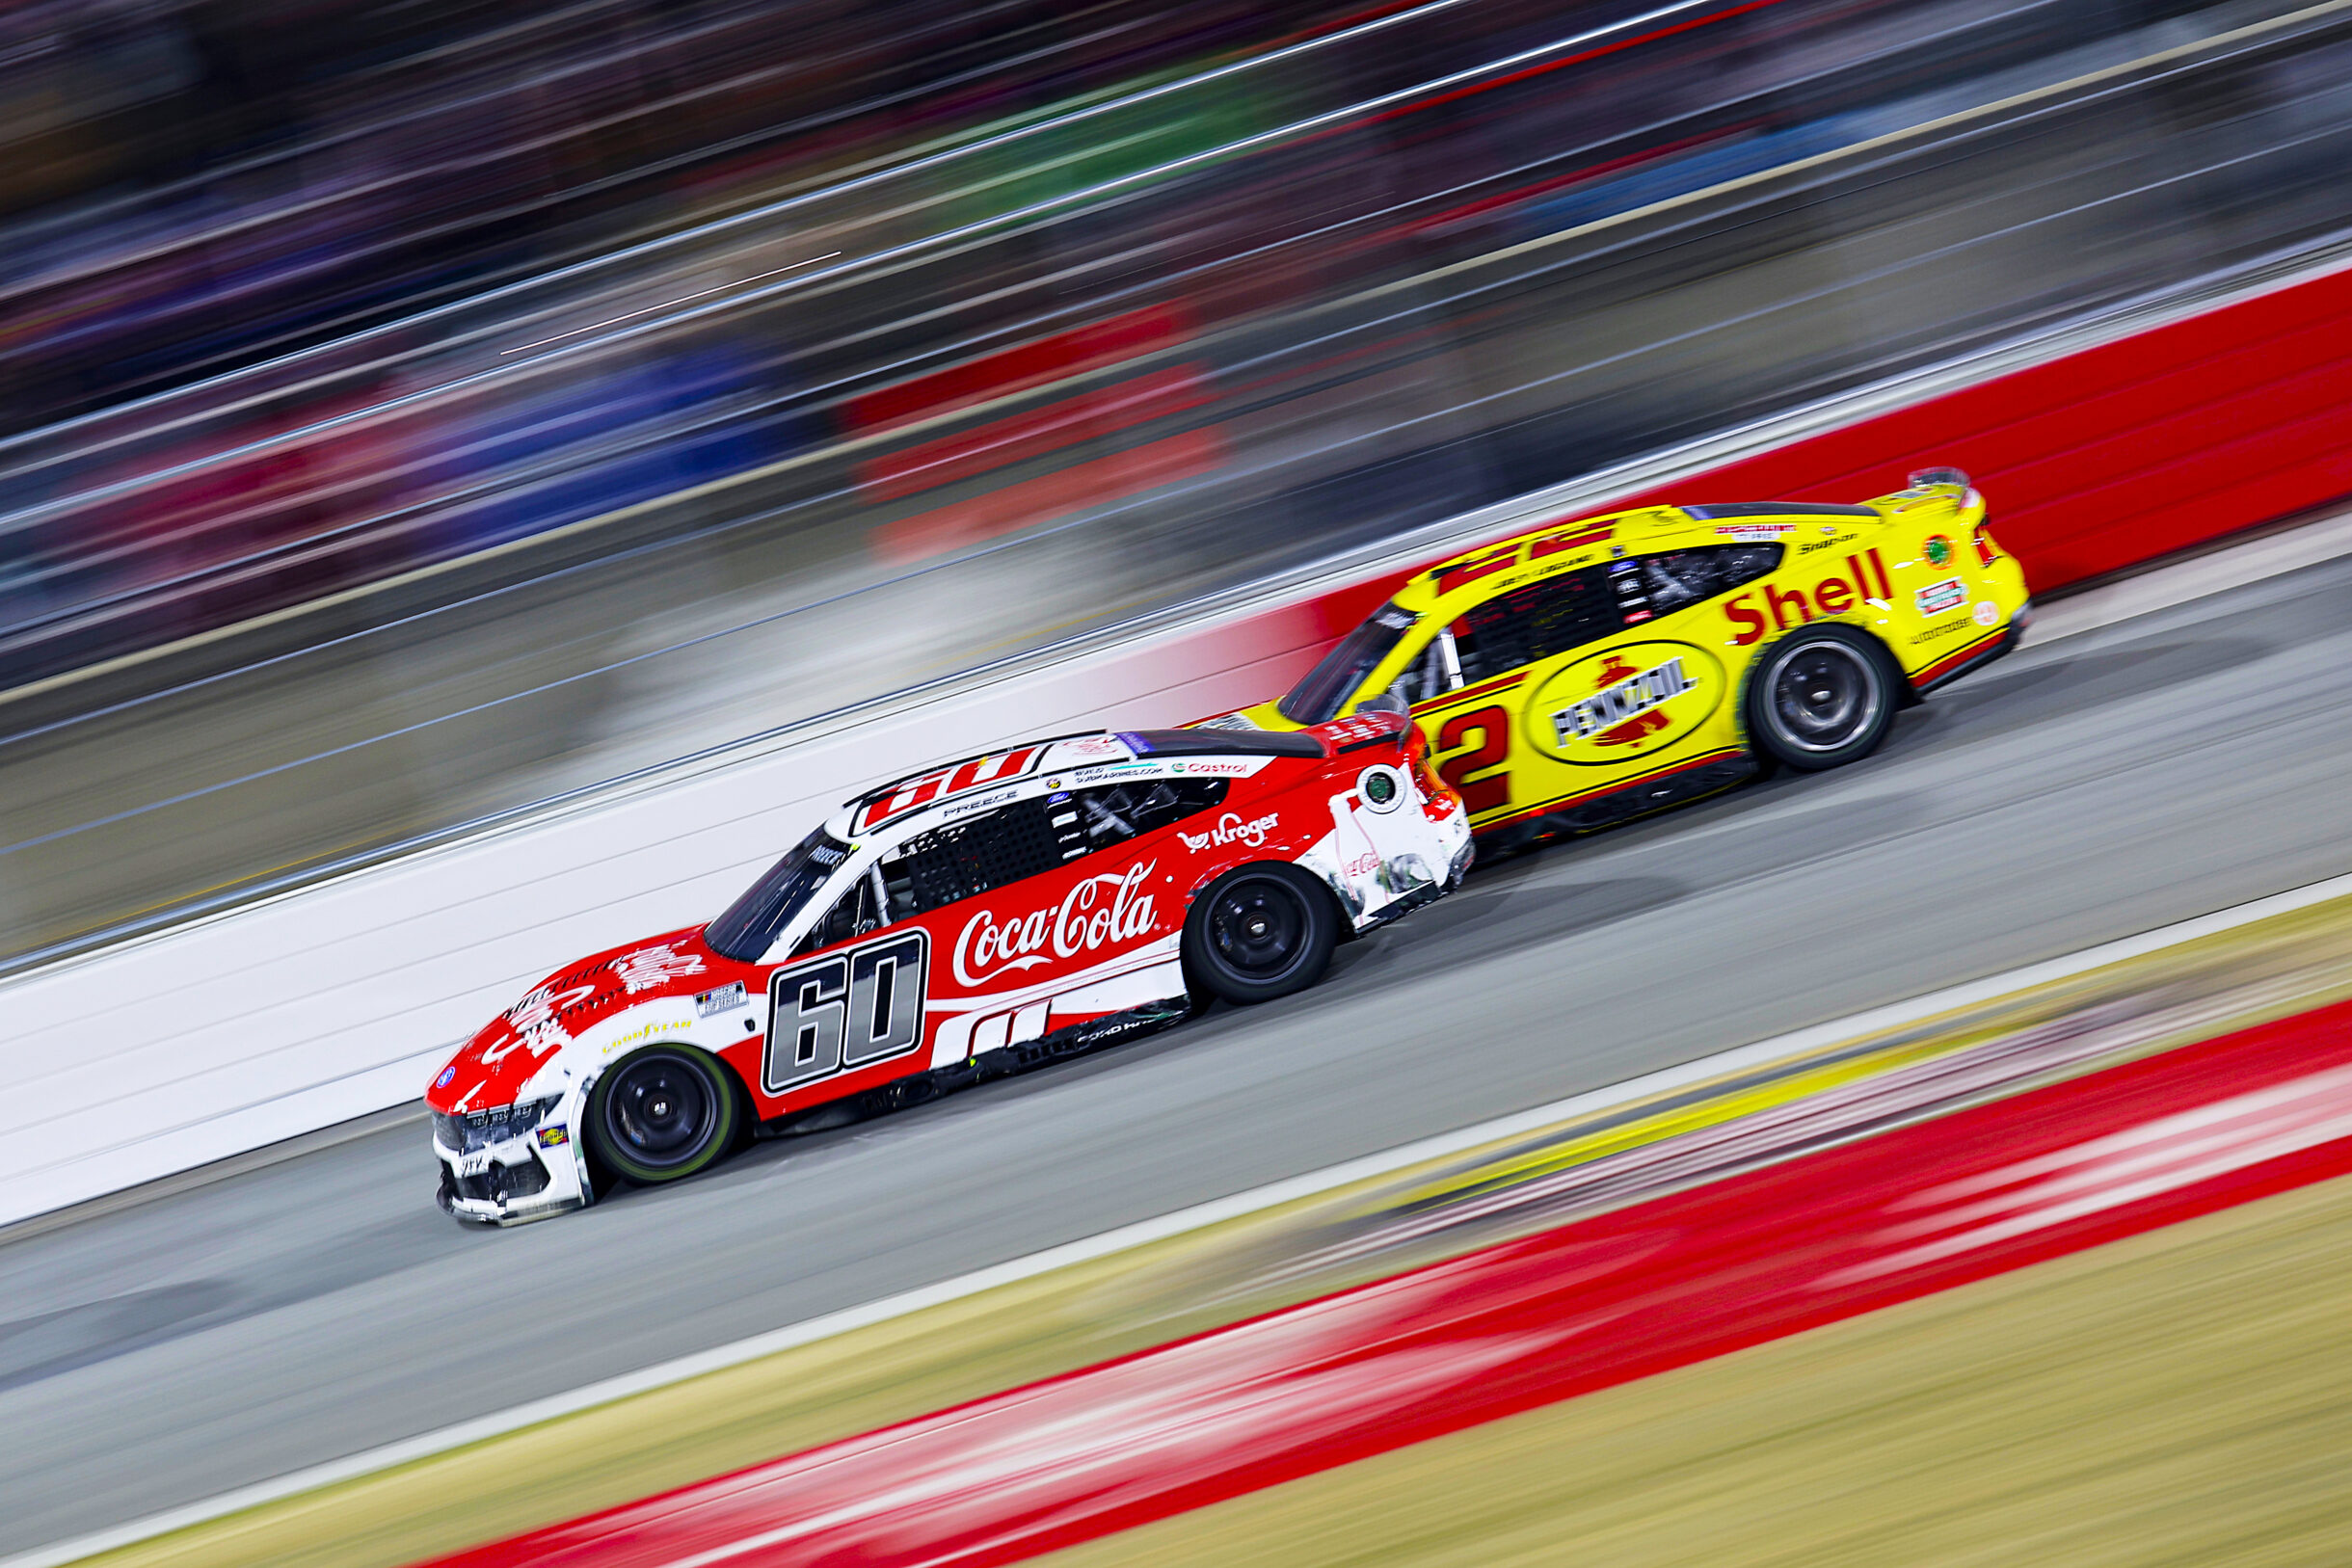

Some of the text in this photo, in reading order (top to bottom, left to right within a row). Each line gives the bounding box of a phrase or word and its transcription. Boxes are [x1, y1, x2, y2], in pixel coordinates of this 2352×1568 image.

[1724, 547, 1893, 646] Shell
[1548, 656, 1698, 749] PENNZOIL
[859, 742, 1041, 832] 60
[943, 789, 1019, 818] PREECE
[1188, 762, 1248, 774] Castrol
[1211, 812, 1280, 847] Kroger
[952, 858, 1158, 988] Coca-Cola
[602, 1020, 692, 1053] GOODYEAR
[761, 927, 931, 1097] 60
